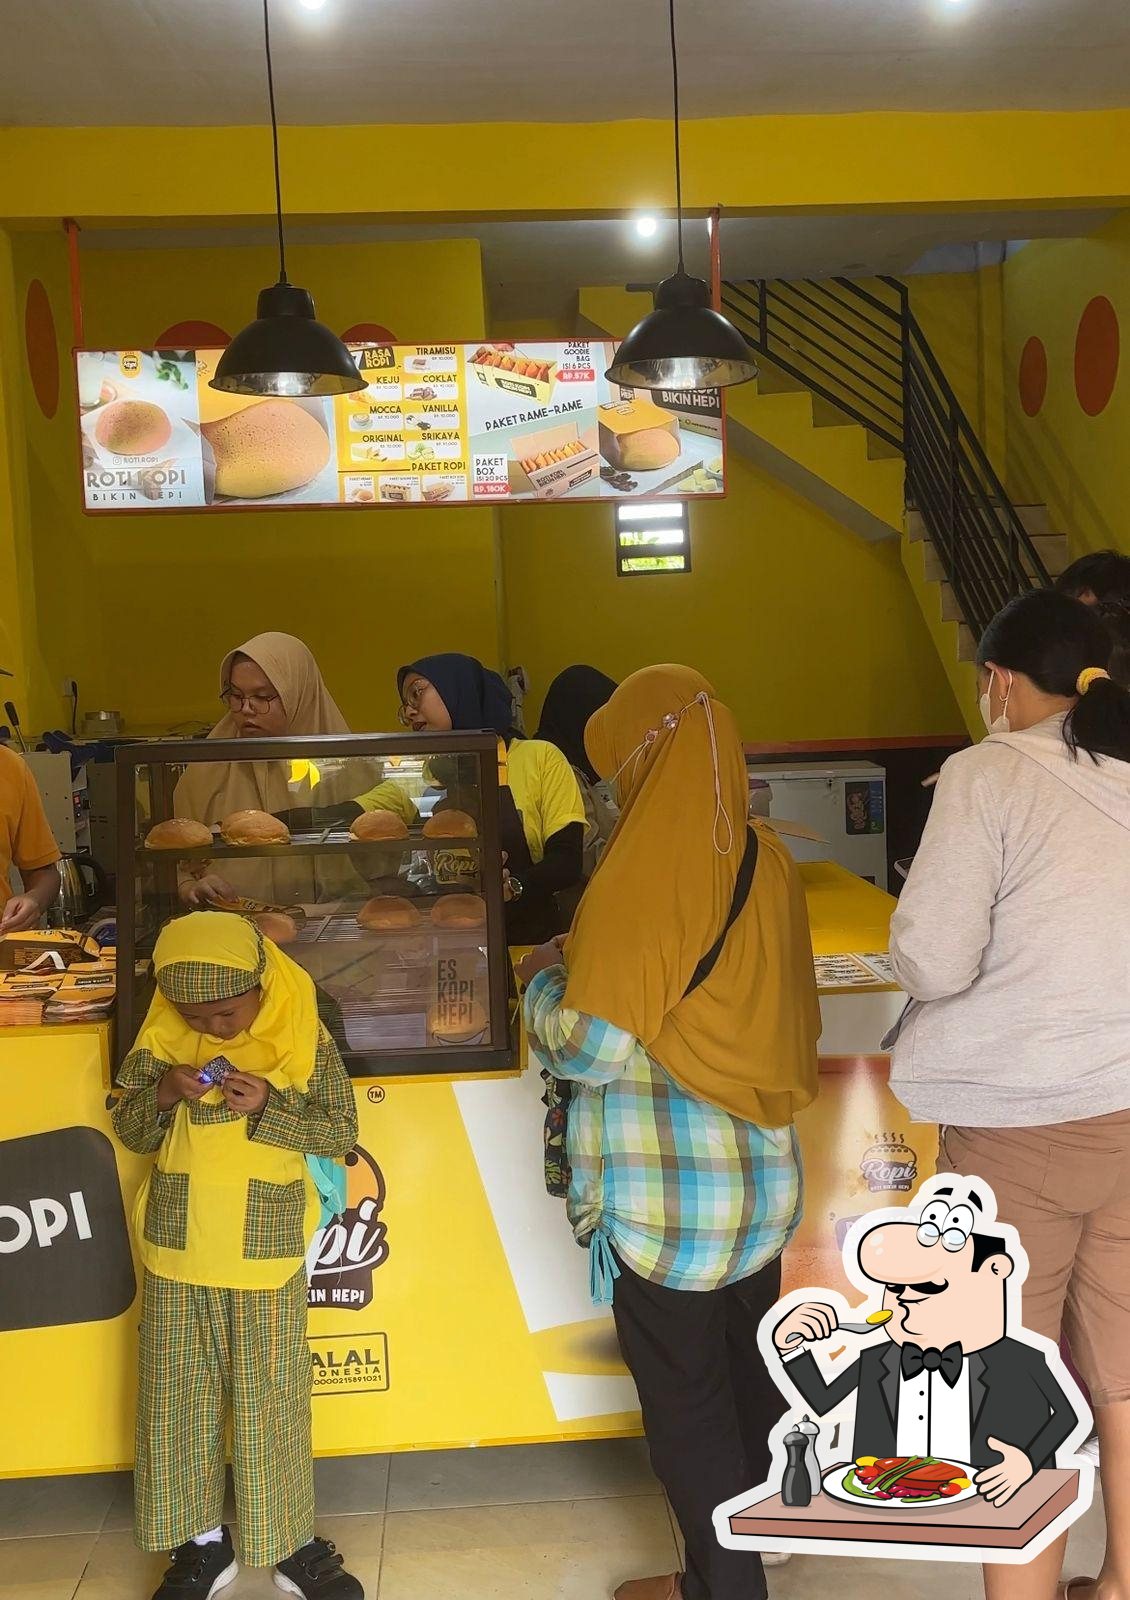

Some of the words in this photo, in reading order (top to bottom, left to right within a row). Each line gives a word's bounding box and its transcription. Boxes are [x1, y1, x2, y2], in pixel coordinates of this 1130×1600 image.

[364, 348, 391, 359] RASA
[416, 346, 456, 356] TIRAMISU
[365, 356, 390, 368] ROPI
[376, 376, 400, 384] KEJU
[422, 374, 457, 383] COKLAT
[661, 391, 692, 406] BIKIN
[693, 395, 720, 409] HEPI
[369, 405, 402, 414] MOCCA
[422, 404, 459, 413] VANILLA
[485, 416, 517, 431] PAKET
[519, 399, 583, 422] RAME-RAME
[362, 434, 404, 442] ORIGINAL
[421, 432, 460, 440] SRIKAYA
[411, 462, 442, 471] PAKET
[444, 461, 466, 470] ROPI
[475, 457, 504, 466] PAKET
[476, 467, 495, 475] BOX
[87, 470, 133, 488] ROTI
[93, 492, 136, 501] BIKIN
[437, 959, 457, 981] ES
[437, 980, 474, 1003] KOPI
[437, 1002, 473, 1026] HEPI
[370, 1090, 382, 1099] TM
[861, 1158, 916, 1185] Ropi
[332, 1289, 365, 1303] HEPI
